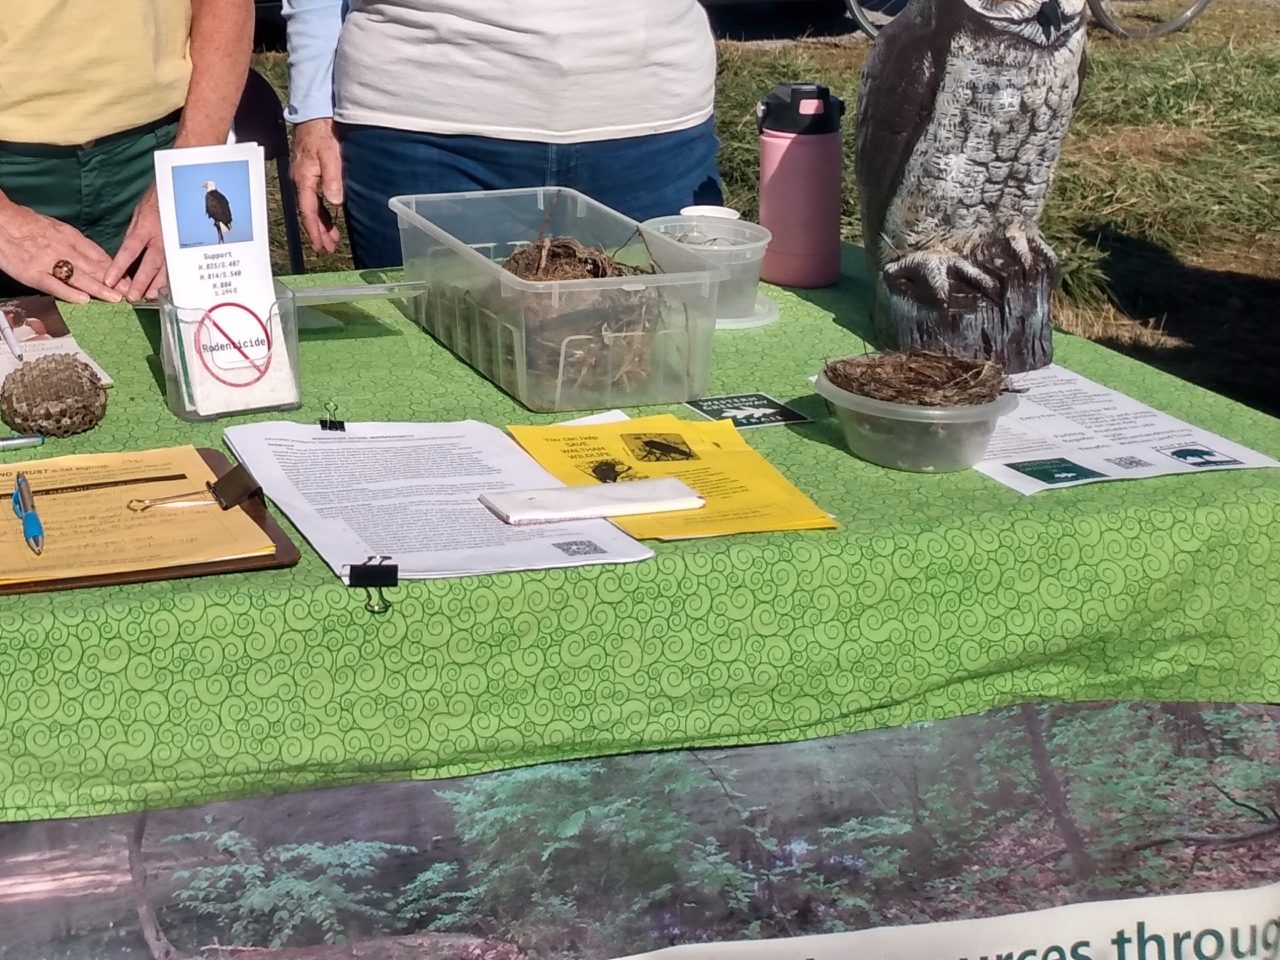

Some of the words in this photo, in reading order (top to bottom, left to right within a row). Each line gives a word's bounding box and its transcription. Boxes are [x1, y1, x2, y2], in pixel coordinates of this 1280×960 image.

[204, 252, 232, 260] Support
[14, 468, 49, 476] TRUST
[1111, 921, 1280, 960] throug
